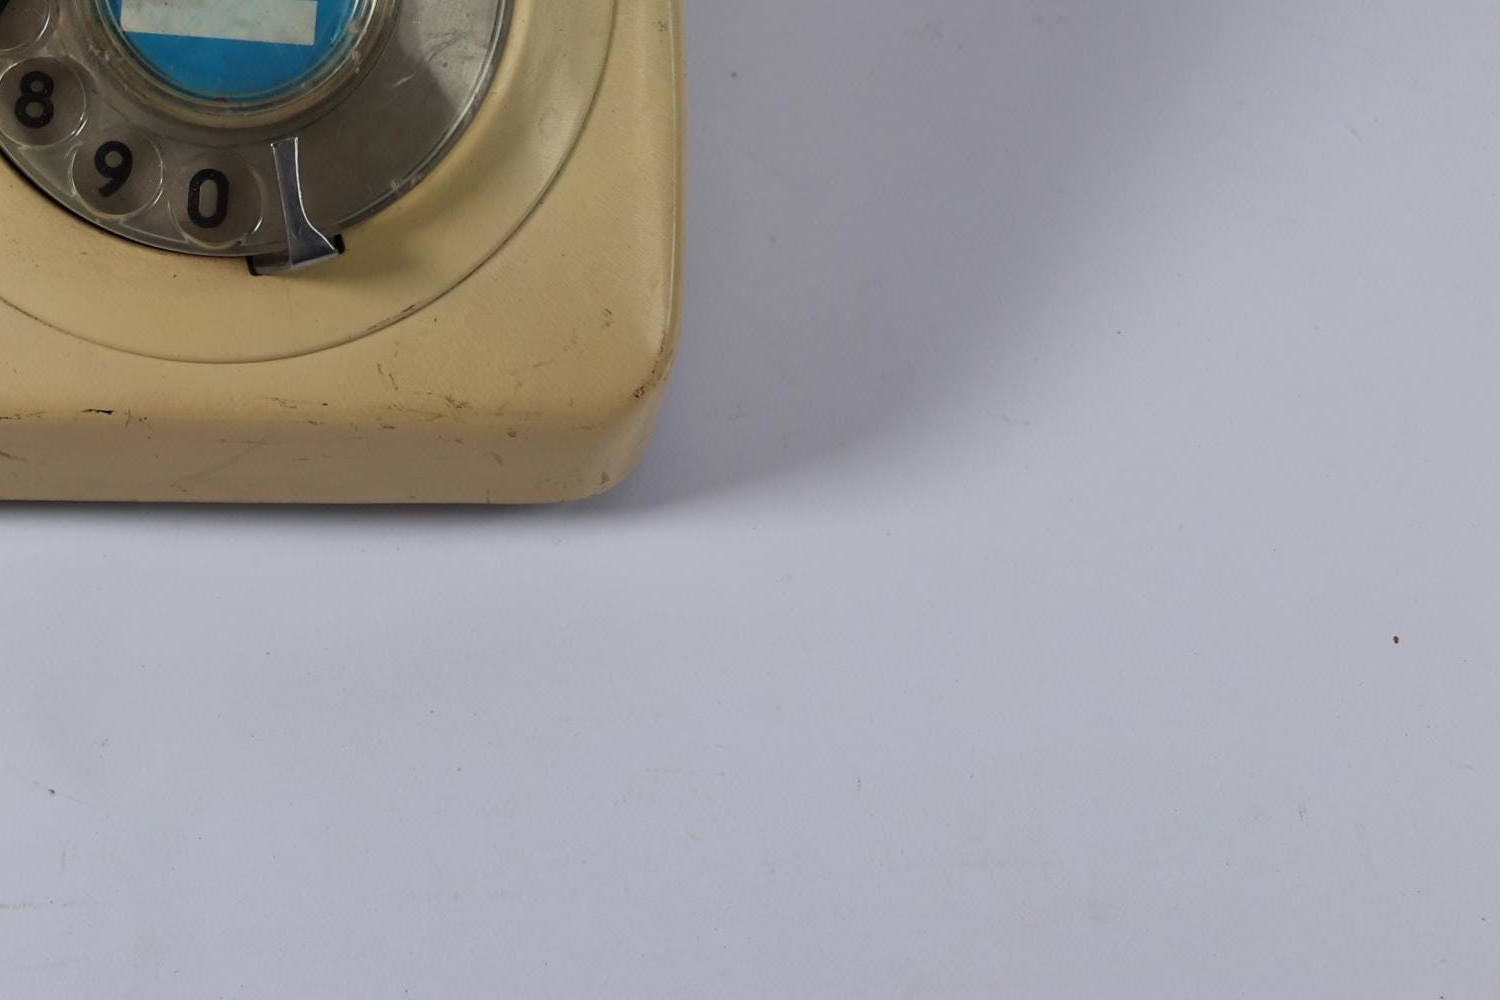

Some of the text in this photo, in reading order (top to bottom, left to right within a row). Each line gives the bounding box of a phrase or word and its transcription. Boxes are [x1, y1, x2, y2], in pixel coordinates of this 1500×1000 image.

[14, 70, 56, 129] 8
[94, 141, 134, 198] 9
[187, 168, 230, 229] 0
